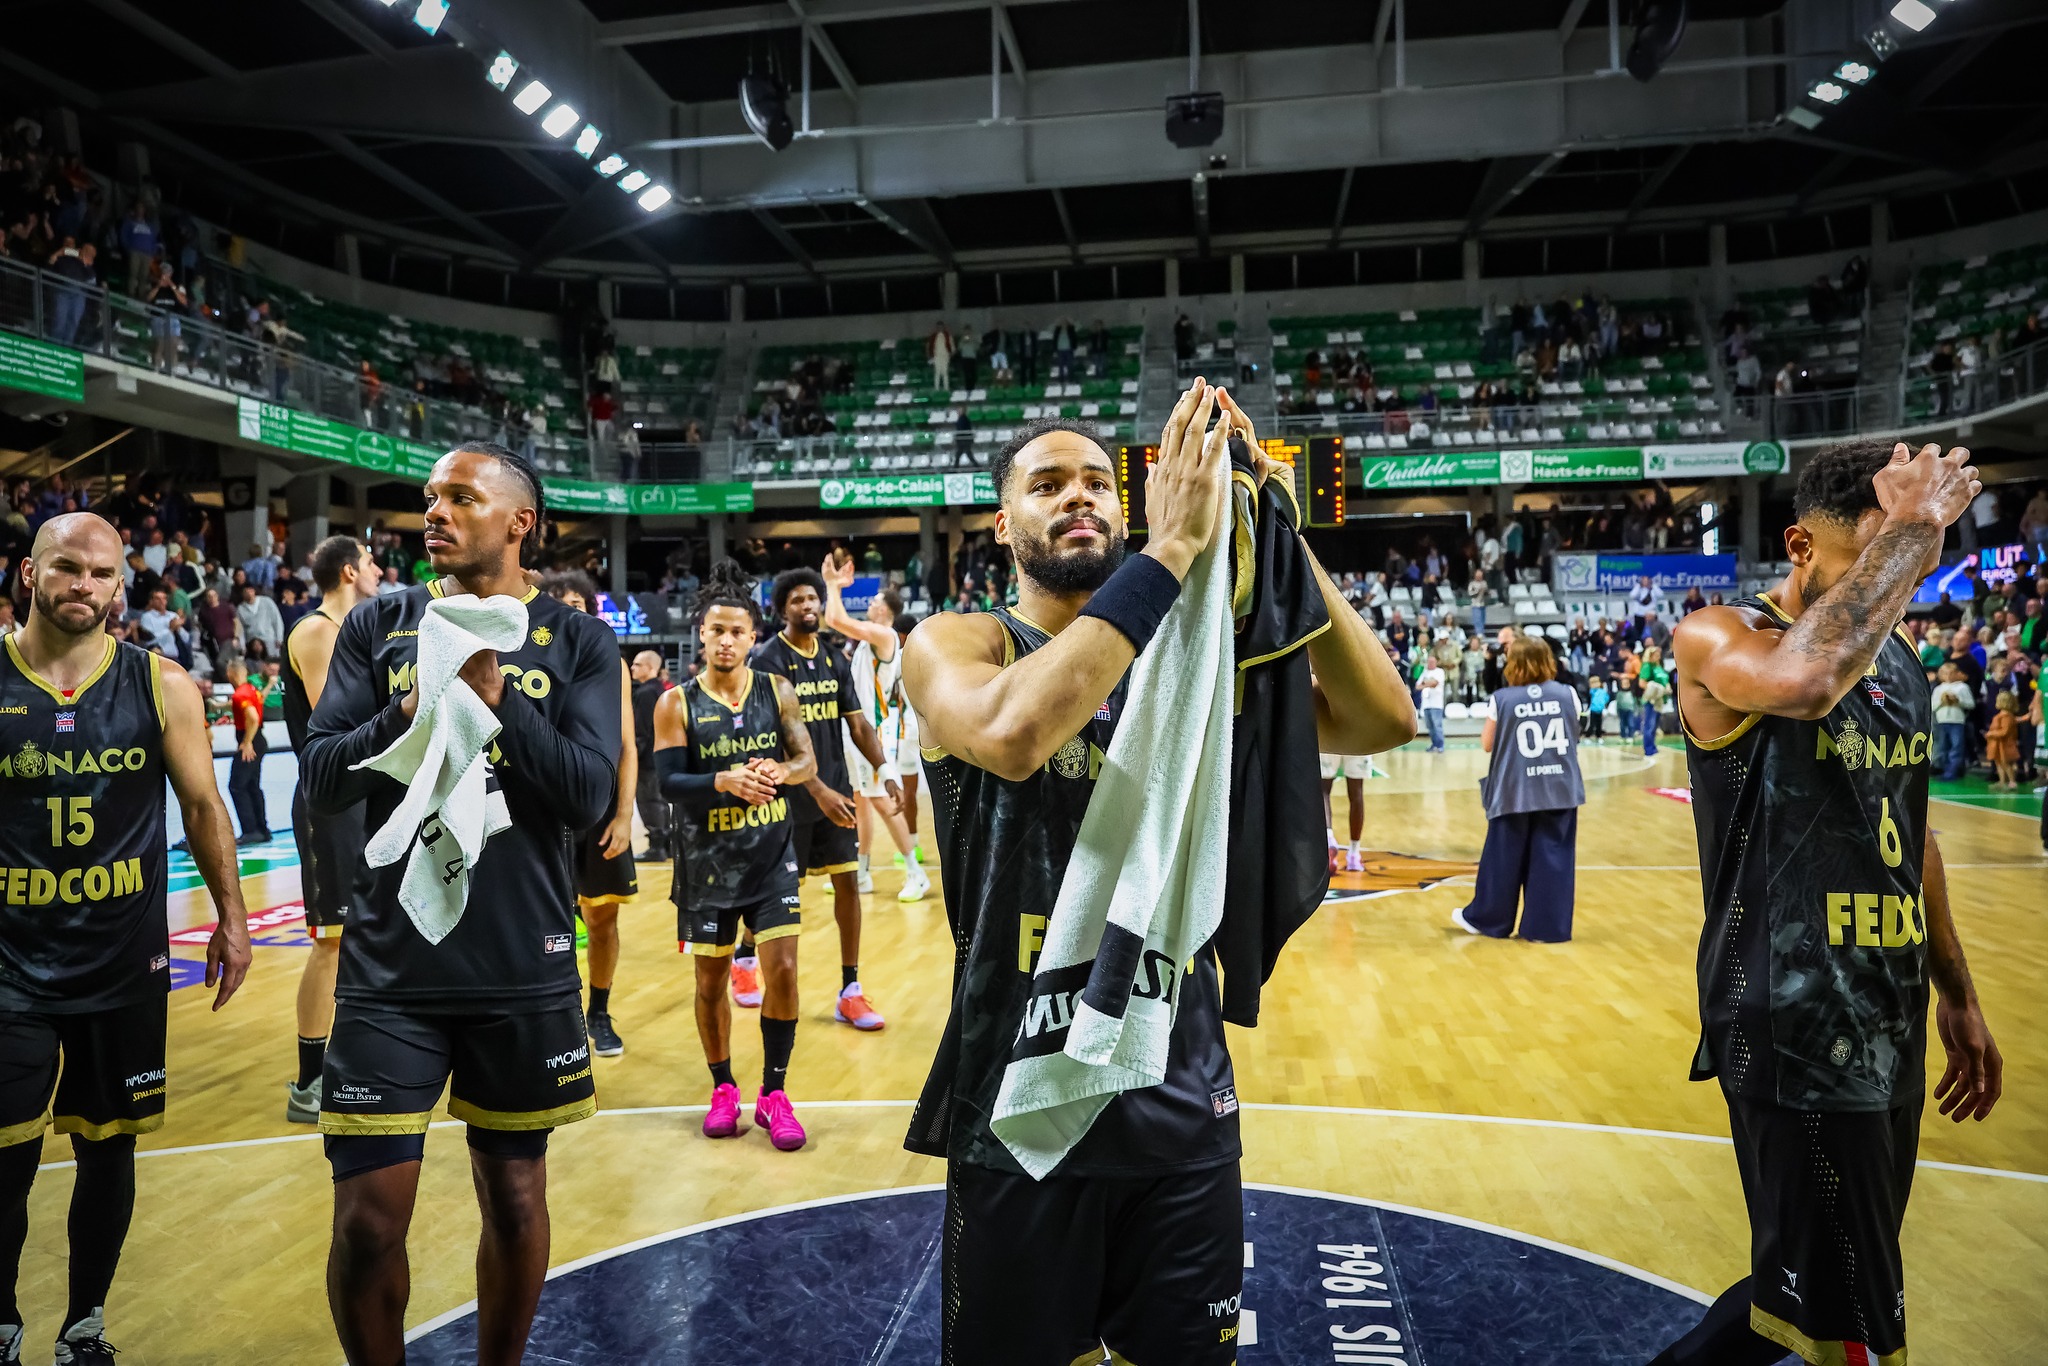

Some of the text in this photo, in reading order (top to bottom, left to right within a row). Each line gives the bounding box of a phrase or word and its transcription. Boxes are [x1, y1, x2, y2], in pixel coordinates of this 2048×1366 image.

[1534, 454, 1569, 466] Région
[1534, 464, 1639, 478] Hauts-de-France
[844, 478, 943, 495] Pas-de-Calais
[1600, 559, 1642, 572] Région
[1981, 544, 2024, 570] NUIT
[1600, 571, 1730, 588] Hautde-France
[1514, 700, 1561, 718] CLUB
[1516, 717, 1570, 758] 04
[1526, 764, 1564, 777] LE PORTEL
[46, 796, 95, 847] 15
[708, 797, 787, 833] FEDCOM
[1879, 797, 1902, 867] 6
[1316, 1243, 1393, 1309] 1964
